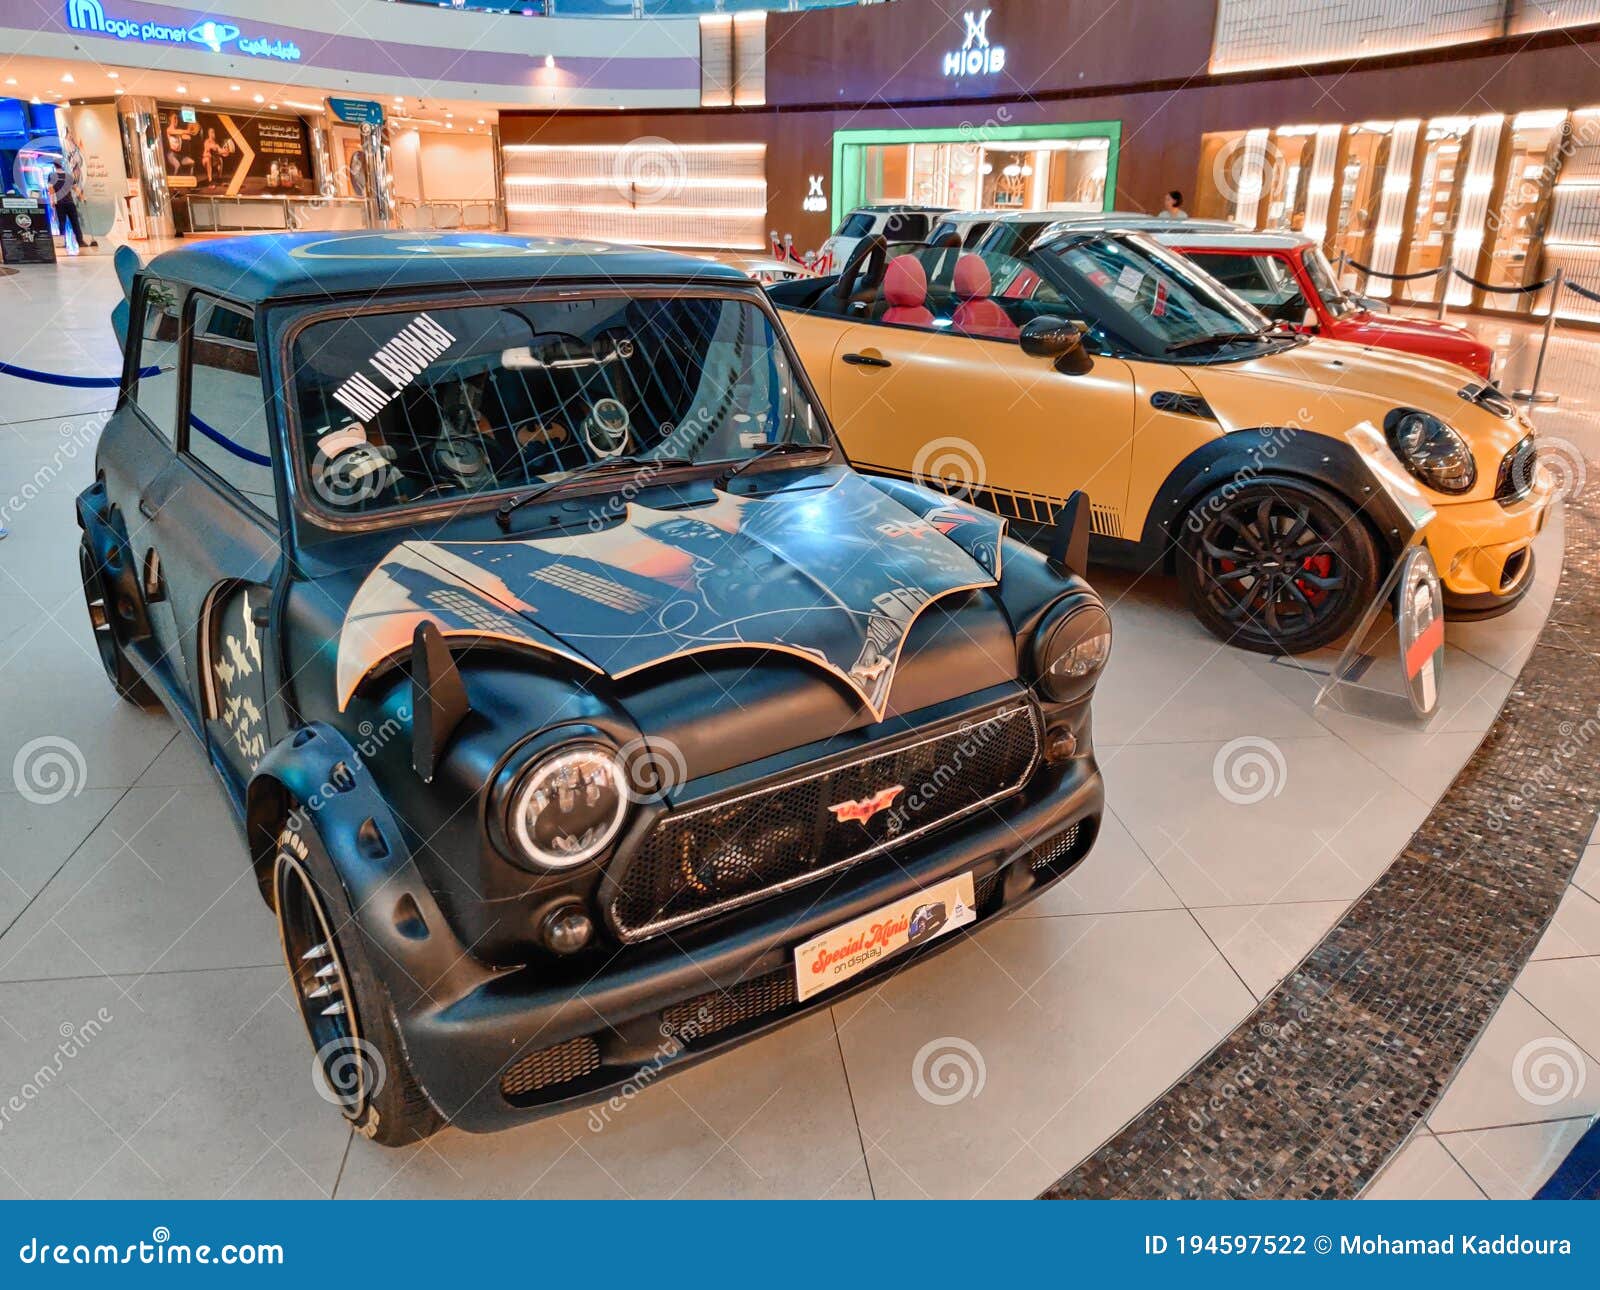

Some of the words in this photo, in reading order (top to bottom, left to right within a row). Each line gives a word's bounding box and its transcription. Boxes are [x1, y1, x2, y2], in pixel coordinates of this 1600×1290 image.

[67, 0, 139, 38] Magic
[141, 21, 187, 42] planet
[812, 931, 865, 974] Special
[865, 914, 909, 946] Minis
[834, 961, 848, 975] on
[848, 947, 883, 969] display
